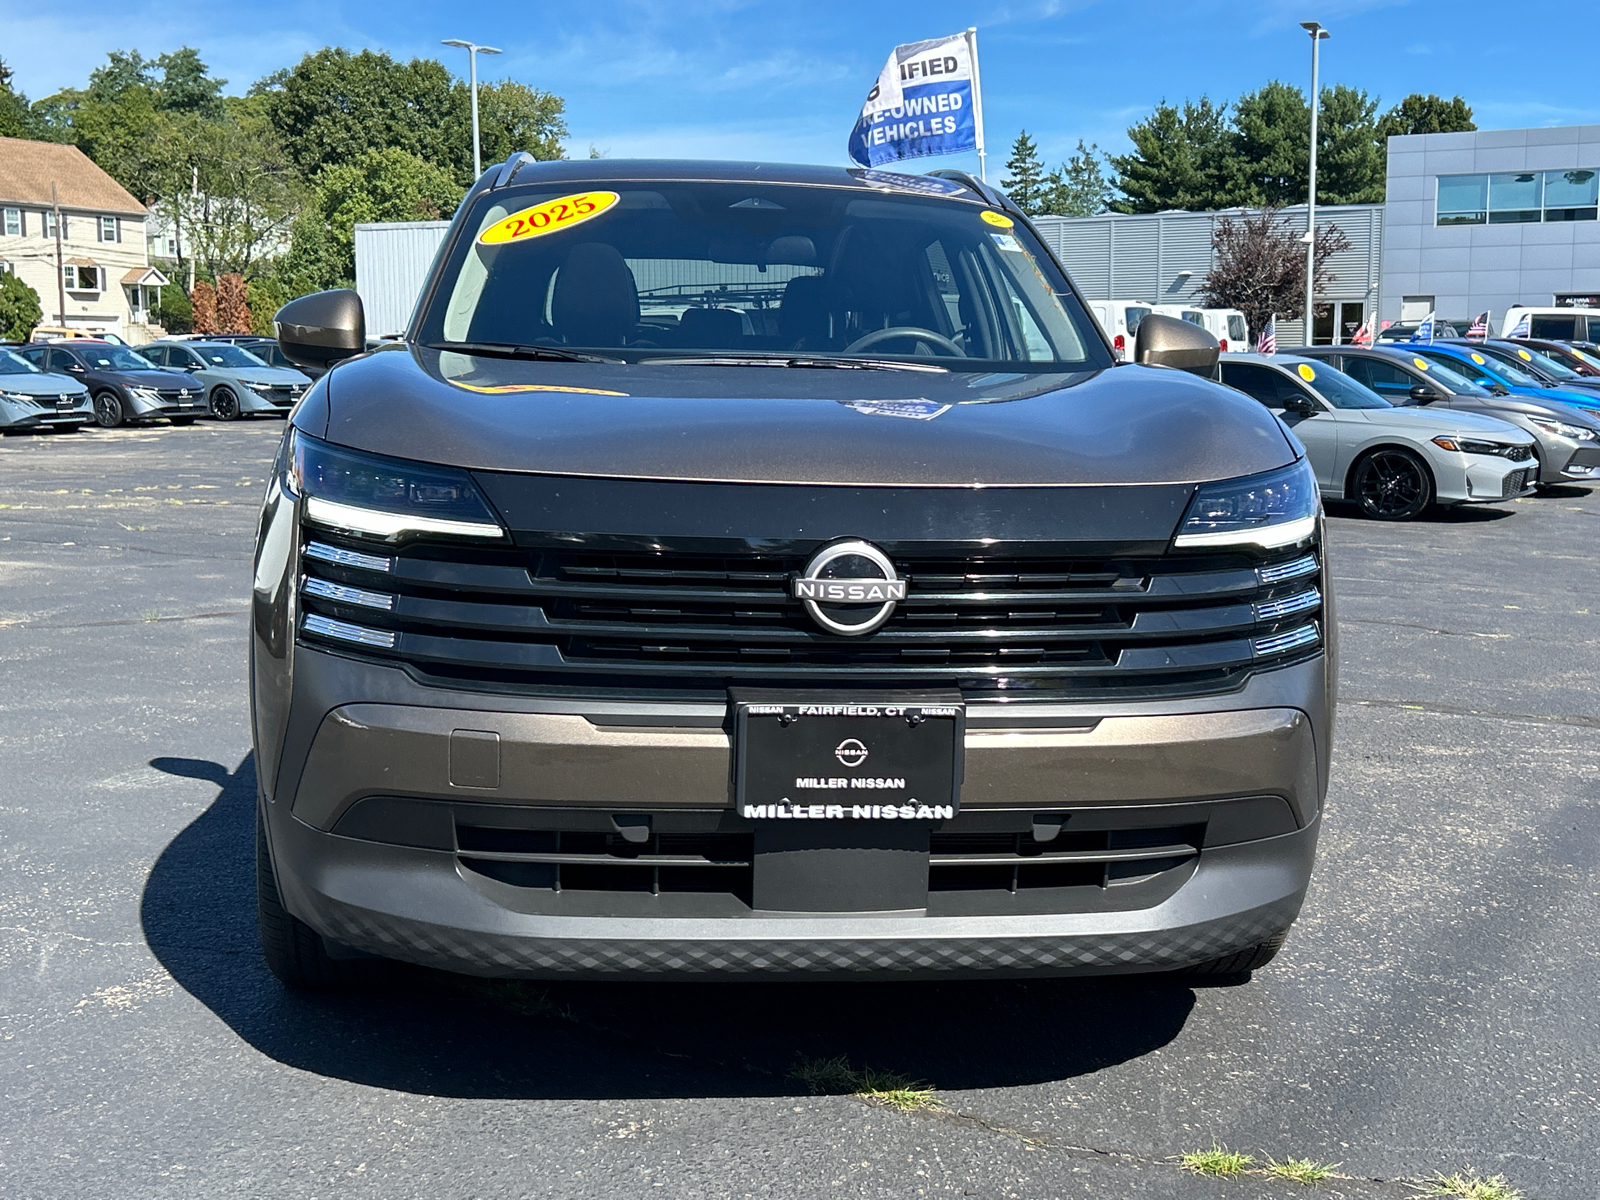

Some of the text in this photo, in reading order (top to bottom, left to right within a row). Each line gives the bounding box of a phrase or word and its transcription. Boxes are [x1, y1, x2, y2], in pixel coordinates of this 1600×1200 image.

[901, 56, 958, 81] IFIED
[861, 115, 957, 148] VEHICLES
[505, 196, 596, 238] 2025
[797, 582, 904, 600] NISSAN
[748, 706, 784, 714] NISSAN
[798, 706, 907, 716] FAIRFIELD, CT
[796, 778, 906, 789] MILLER NISSAN
[743, 804, 954, 820] MILLER NISSAN
